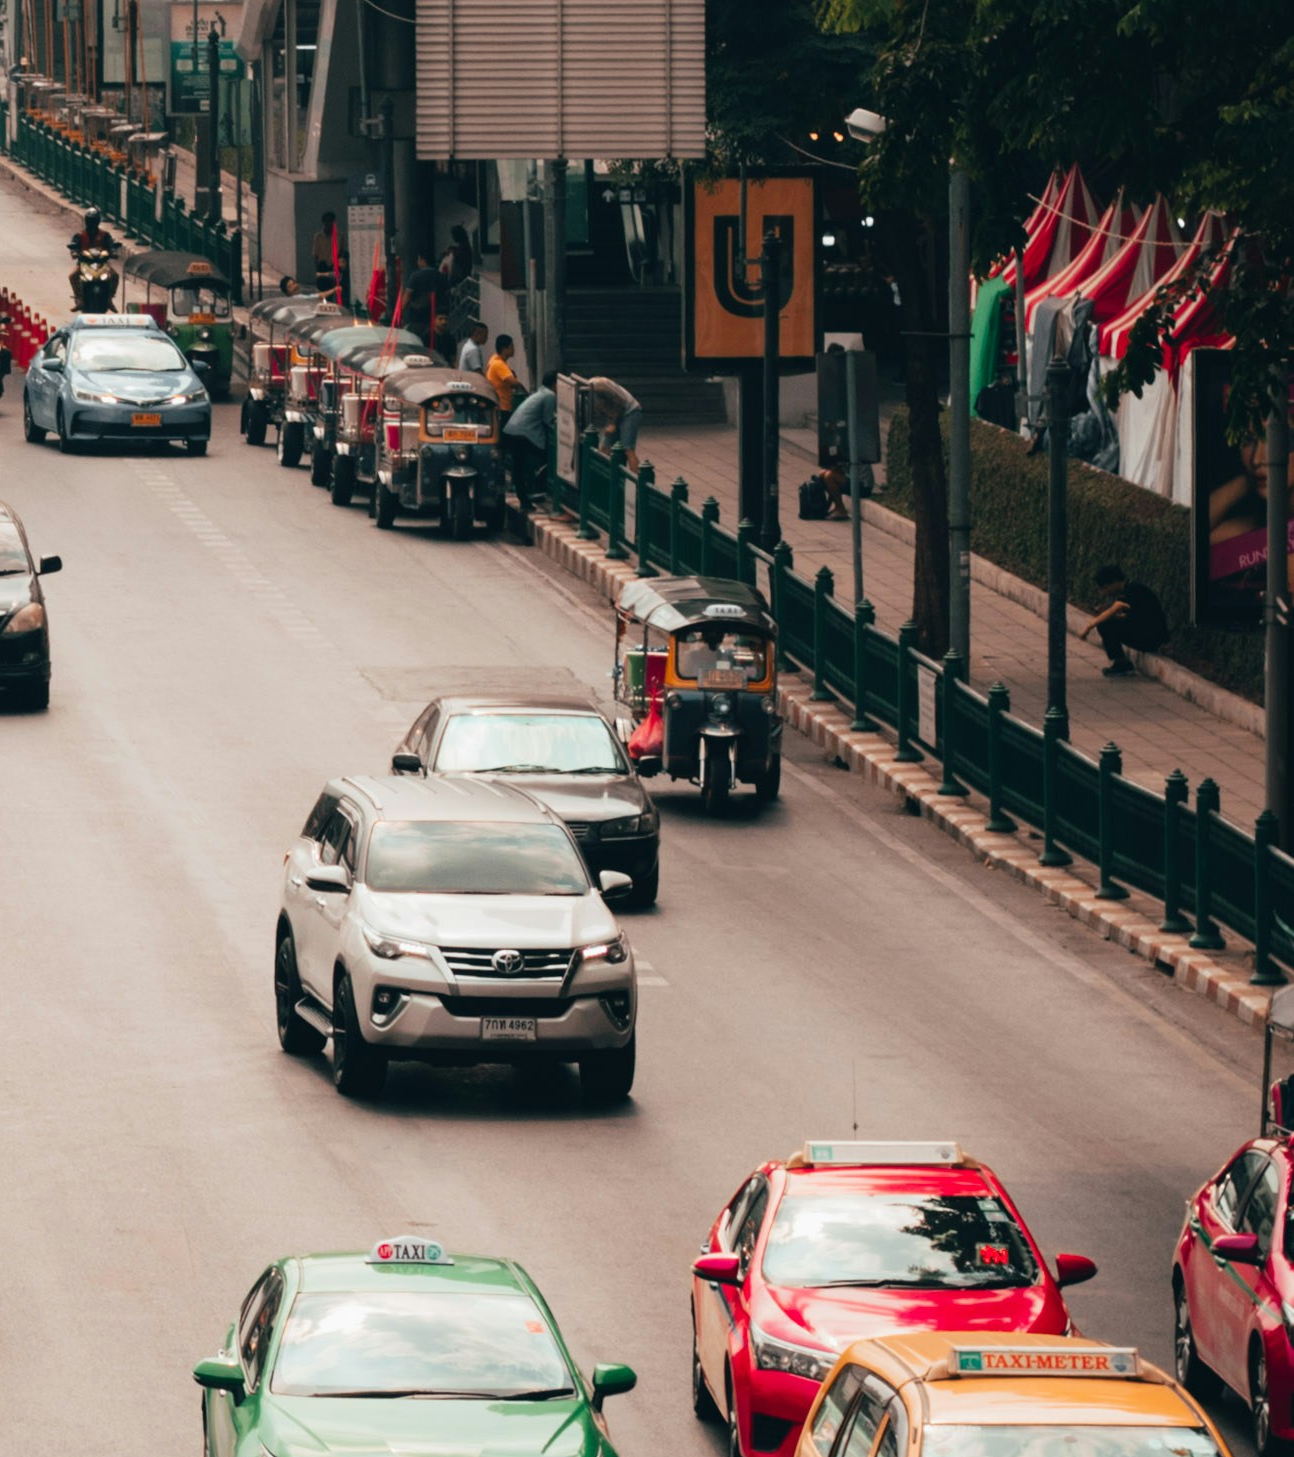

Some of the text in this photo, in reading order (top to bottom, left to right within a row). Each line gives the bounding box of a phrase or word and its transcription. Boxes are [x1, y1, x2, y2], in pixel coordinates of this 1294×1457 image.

[509, 1020, 534, 1031] 4962
[394, 1245, 425, 1260] TAXI
[984, 1354, 1109, 1370] TAXI-METER
